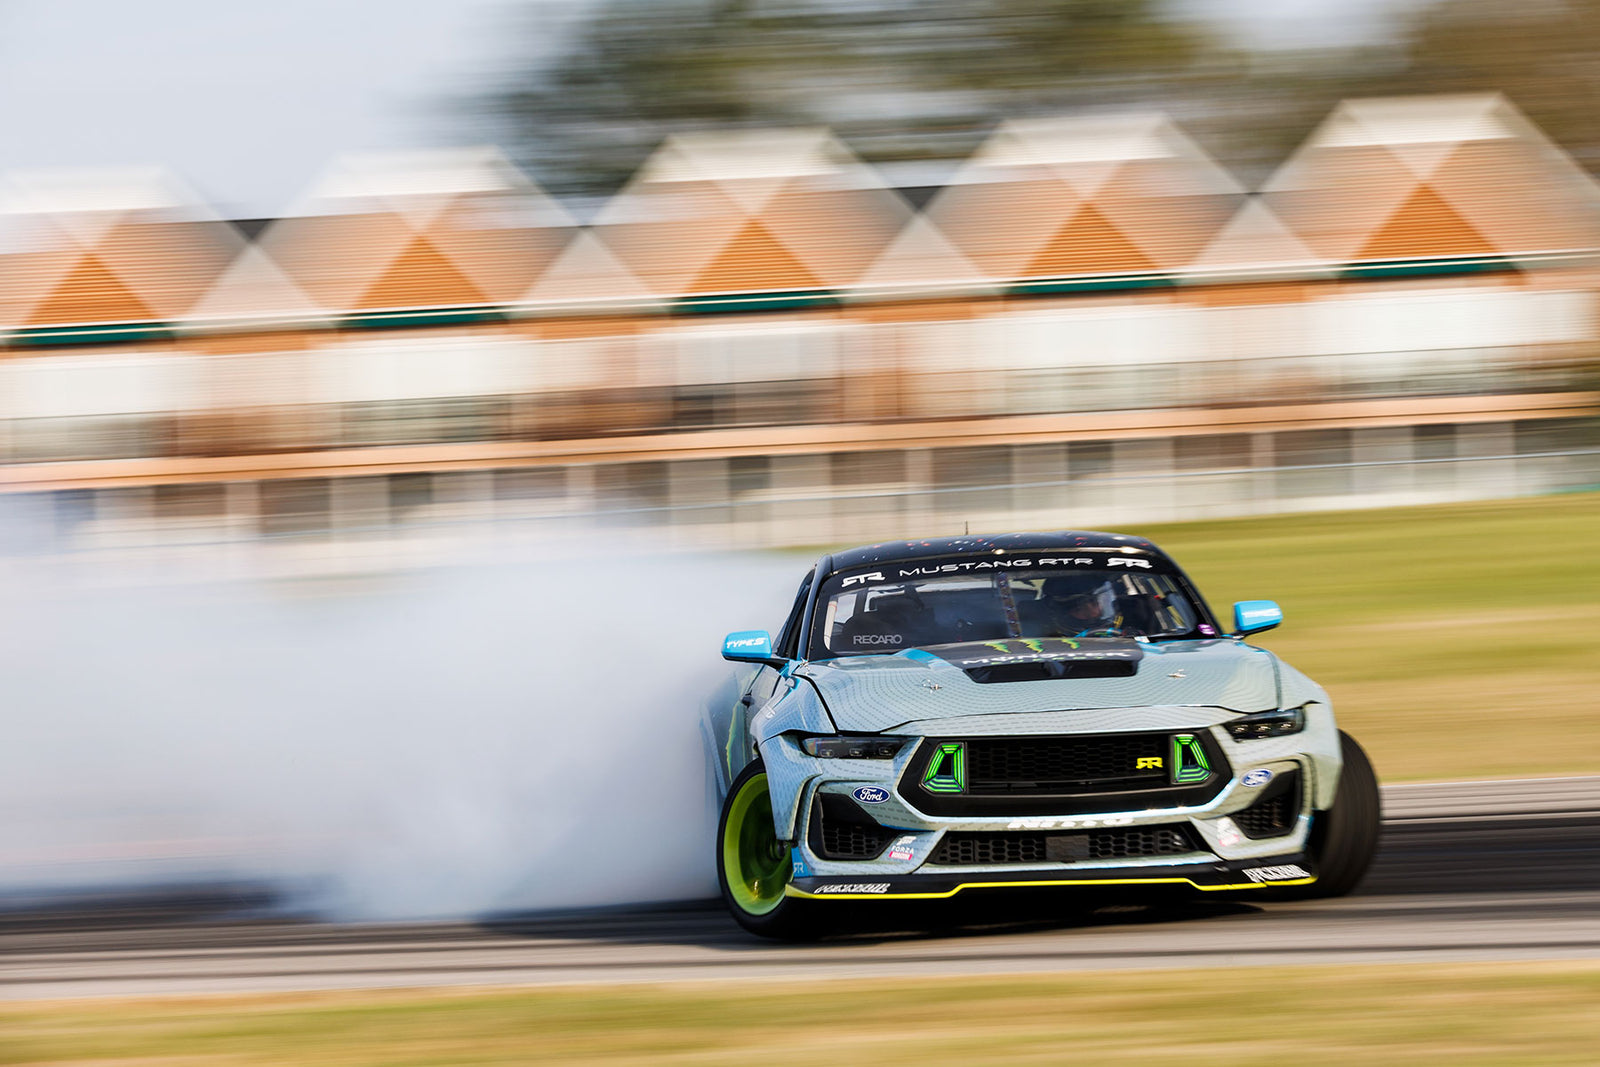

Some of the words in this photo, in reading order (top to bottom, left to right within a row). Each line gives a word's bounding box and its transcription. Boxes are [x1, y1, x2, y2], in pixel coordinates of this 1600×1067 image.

[899, 558, 1032, 577] MUSTANG
[1038, 557, 1094, 566] RTR
[853, 634, 903, 645] RECARO
[860, 788, 883, 801] Ford
